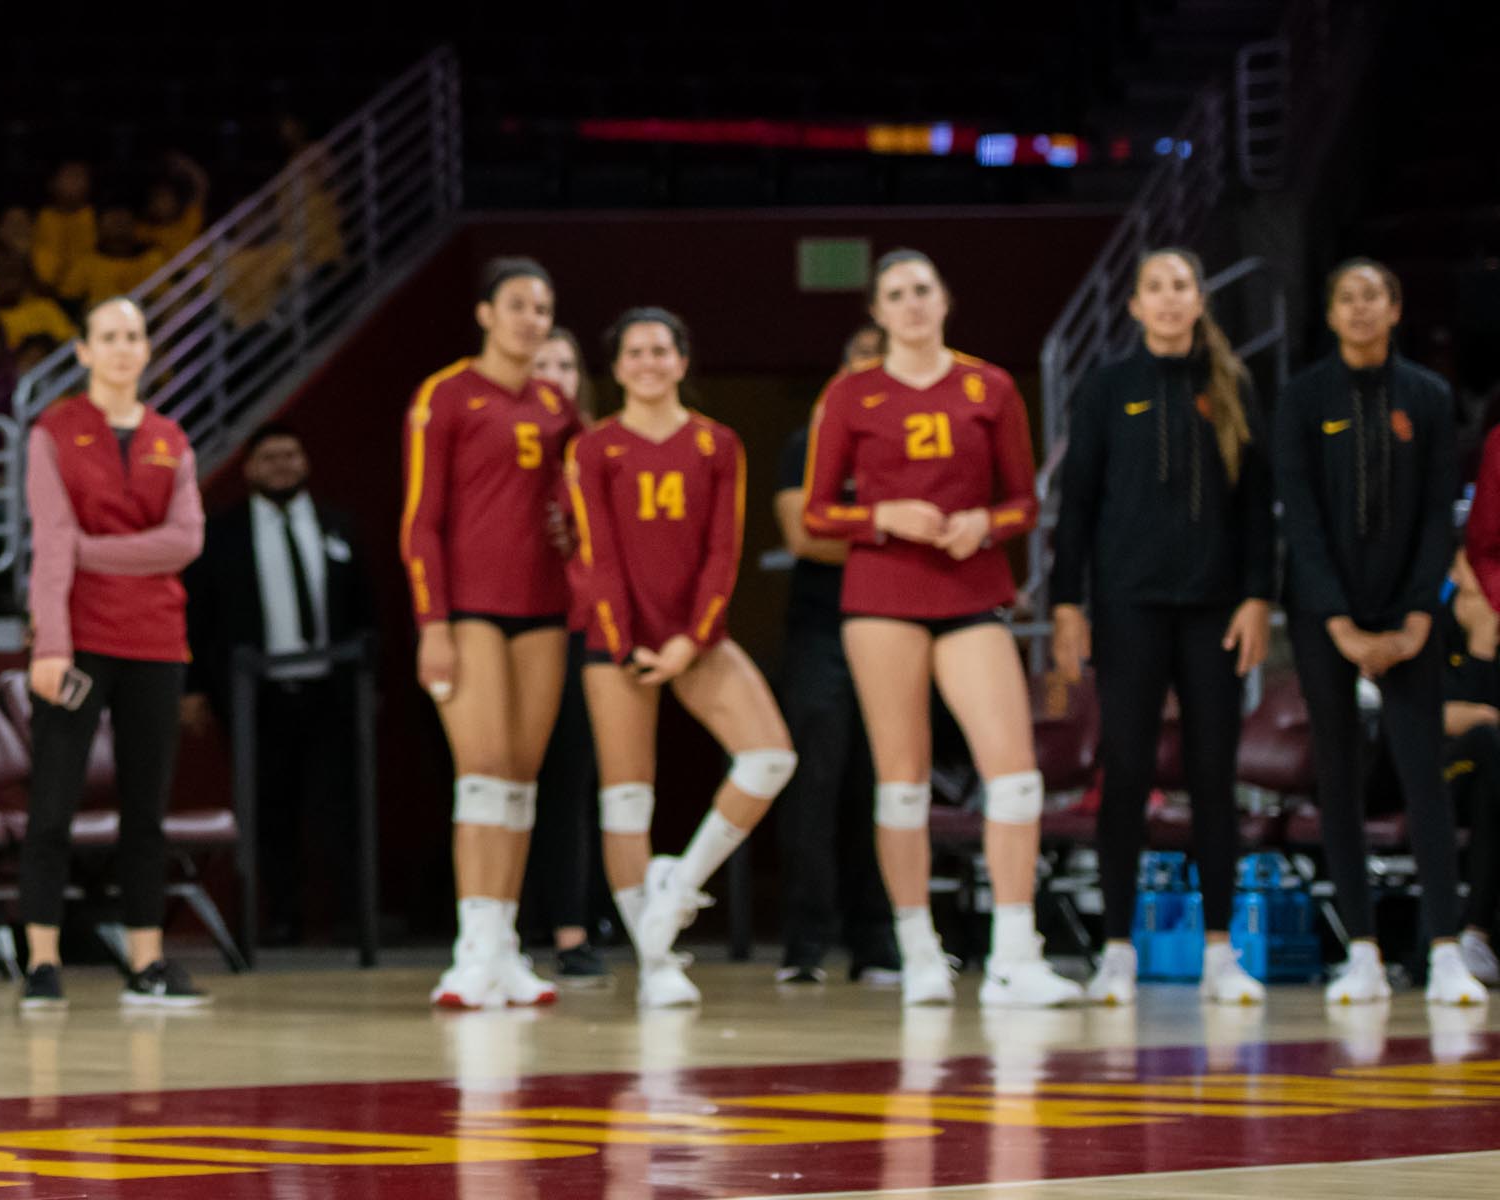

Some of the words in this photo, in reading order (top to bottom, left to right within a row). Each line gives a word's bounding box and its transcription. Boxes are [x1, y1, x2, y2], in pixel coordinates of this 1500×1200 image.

[515, 422, 542, 469] 5
[904, 412, 954, 460] 21
[637, 471, 685, 521] 14
